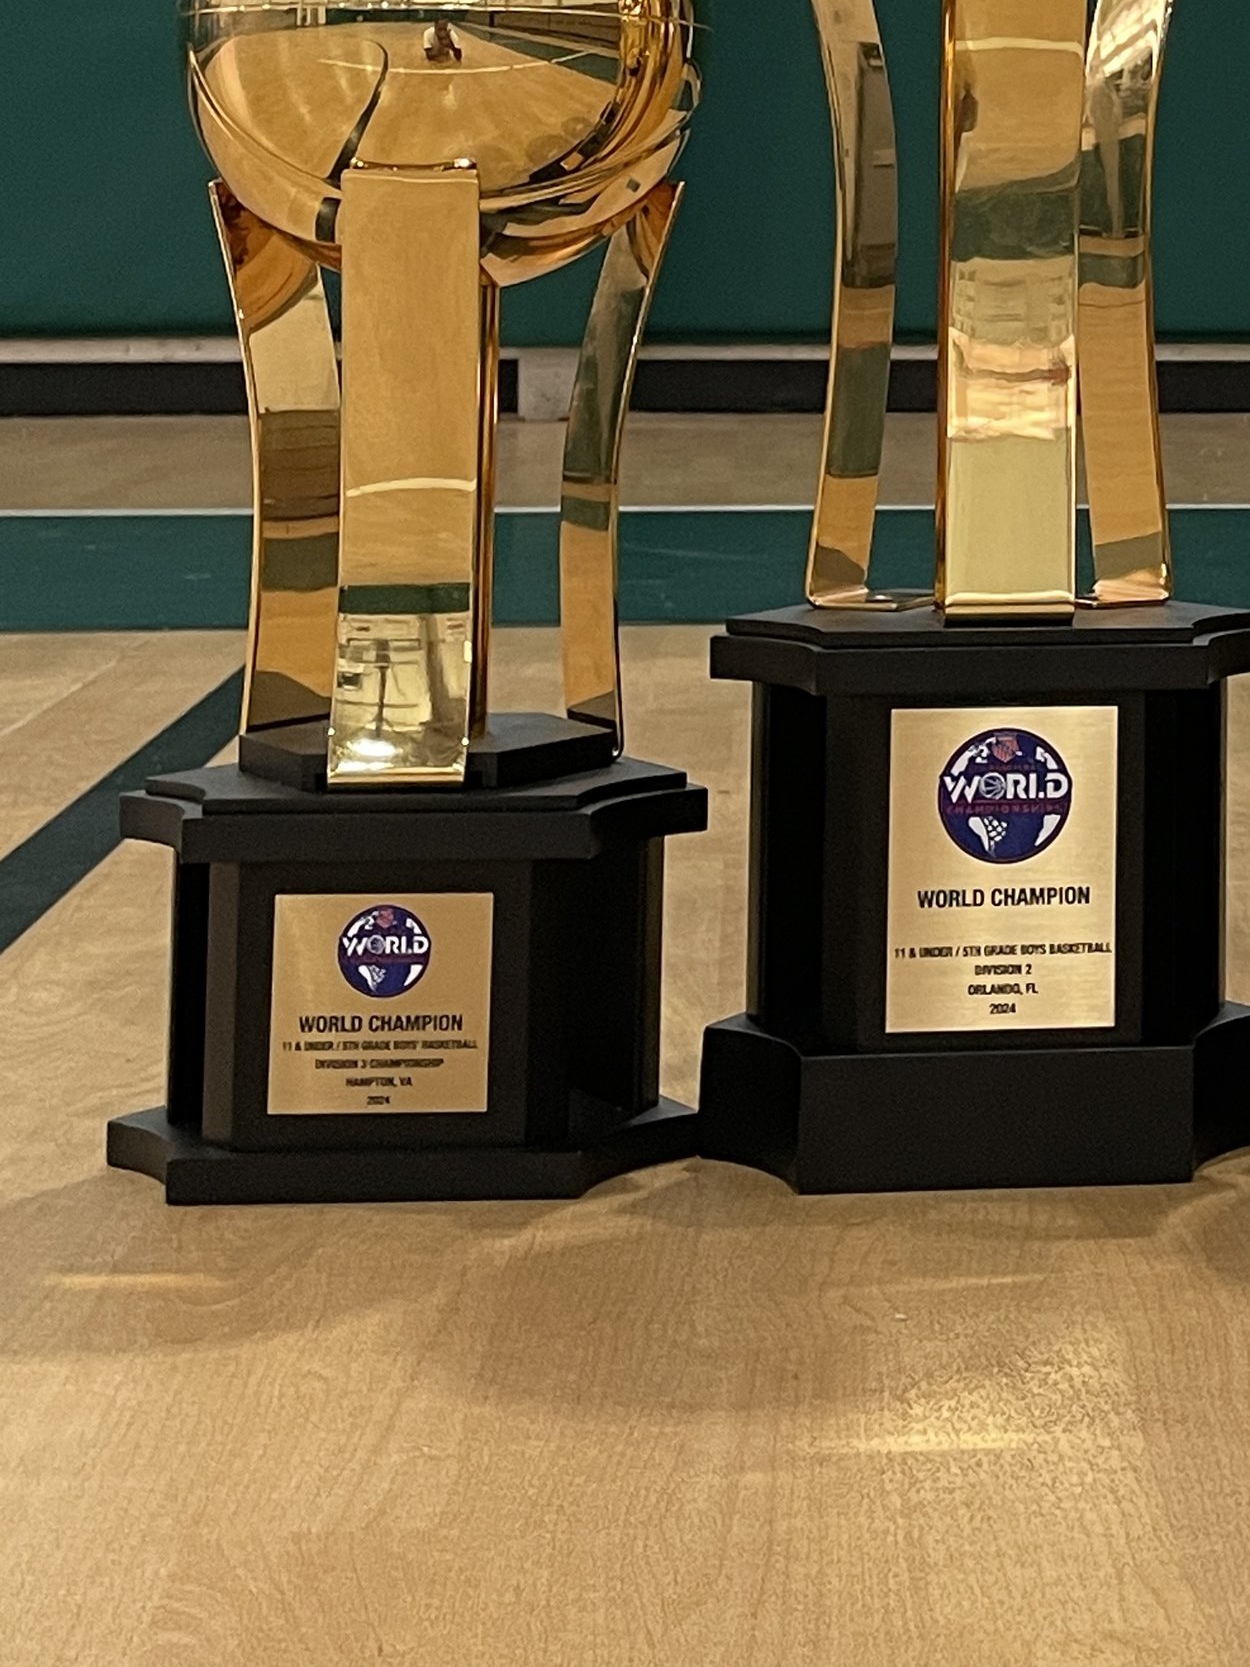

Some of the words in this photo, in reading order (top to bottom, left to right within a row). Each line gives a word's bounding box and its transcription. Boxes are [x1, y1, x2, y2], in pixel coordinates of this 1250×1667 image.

[942, 771, 1070, 805] WORLD
[917, 887, 986, 910] WORLD
[990, 886, 1092, 908] CHAMPION
[341, 934, 431, 957] WORLD
[894, 947, 906, 959] 11
[984, 944, 1018, 957] GRADE
[1048, 942, 1113, 955] BASKETBALL
[973, 964, 1023, 976] DIVISION
[1025, 963, 1033, 975] 2
[1025, 982, 1039, 994] FL
[988, 1002, 1017, 1015] 2024
[298, 1014, 363, 1034] WORLD
[367, 1013, 464, 1033] CHAMPION
